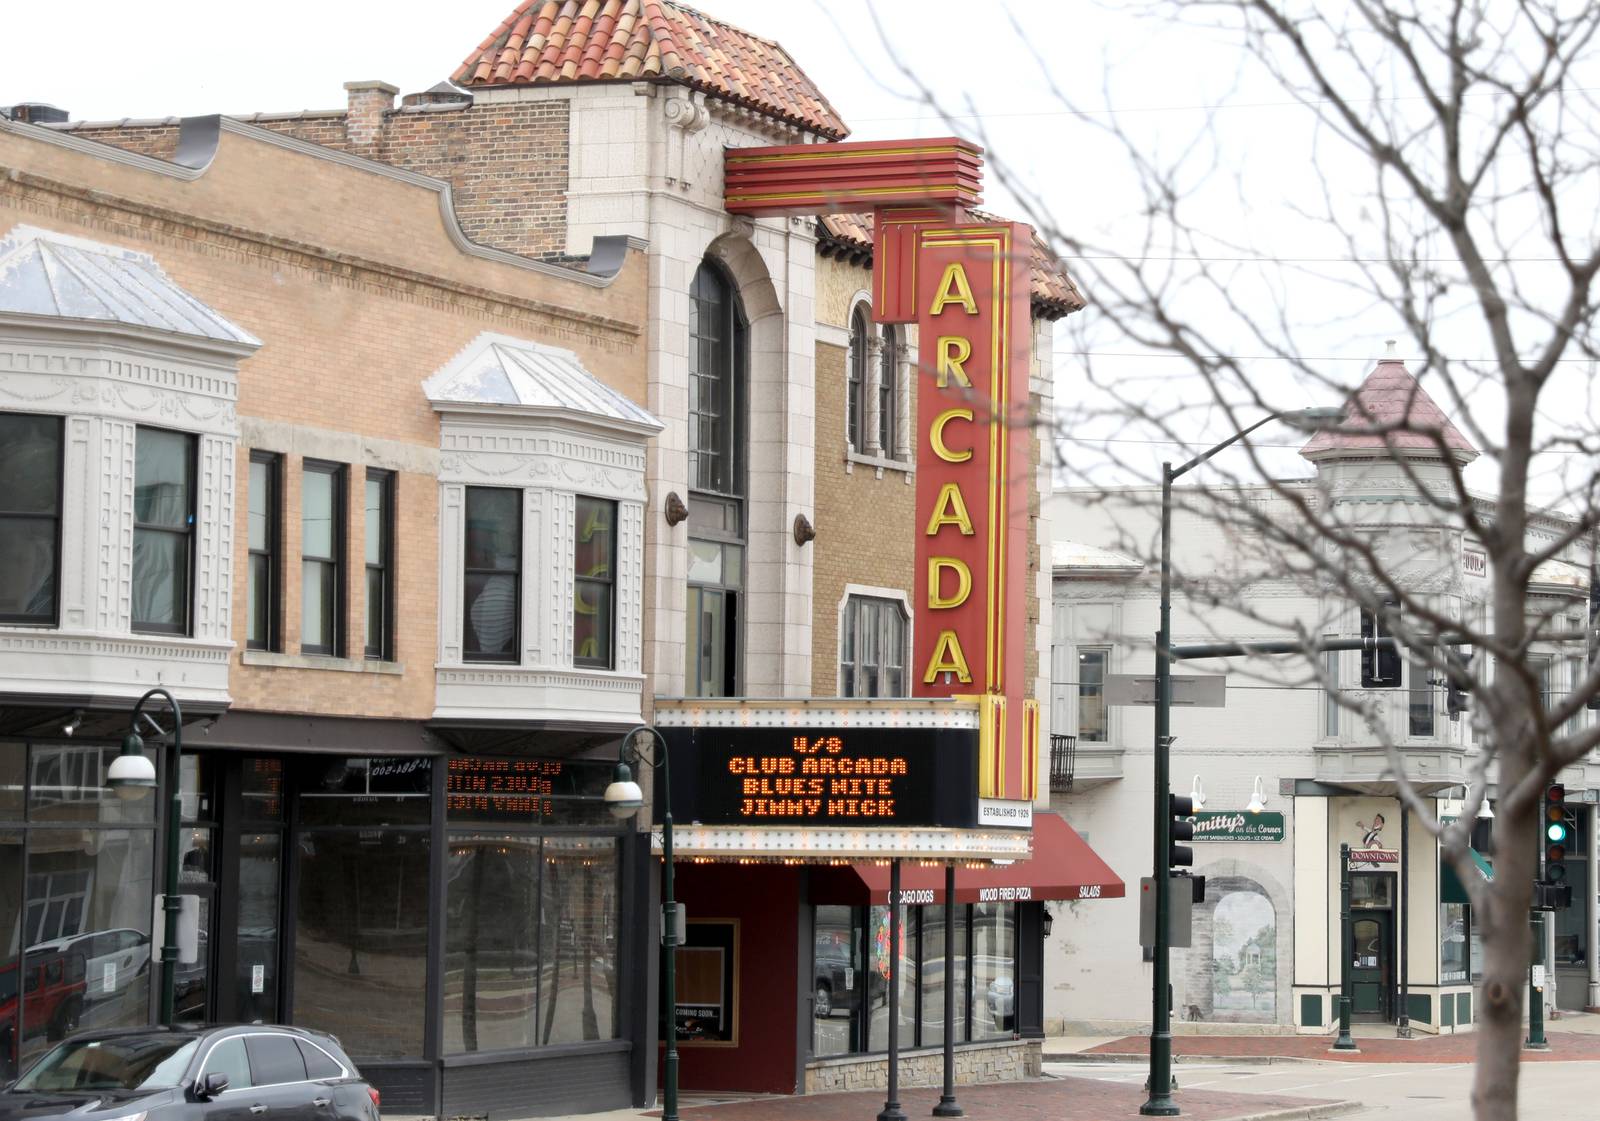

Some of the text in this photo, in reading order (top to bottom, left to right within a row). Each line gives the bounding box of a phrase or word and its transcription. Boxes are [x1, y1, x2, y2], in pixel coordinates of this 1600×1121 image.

[922, 262, 979, 684] ARCADA
[793, 737, 842, 753] 4/8
[729, 757, 906, 774] CLUB ARCADA
[743, 778, 824, 795] BLUES
[741, 799, 821, 815] JIMMY
[983, 807, 1017, 817] ESTABLISHED
[1245, 824, 1257, 833] the
[1258, 824, 1281, 833] Corner
[1351, 852, 1398, 861] DOWNTOWN
[916, 890, 934, 903] DOGS
[980, 887, 1031, 901] WOOD FIRED PIZZA
[1079, 885, 1101, 898] SALADS
[675, 1008, 697, 1017] COMING
